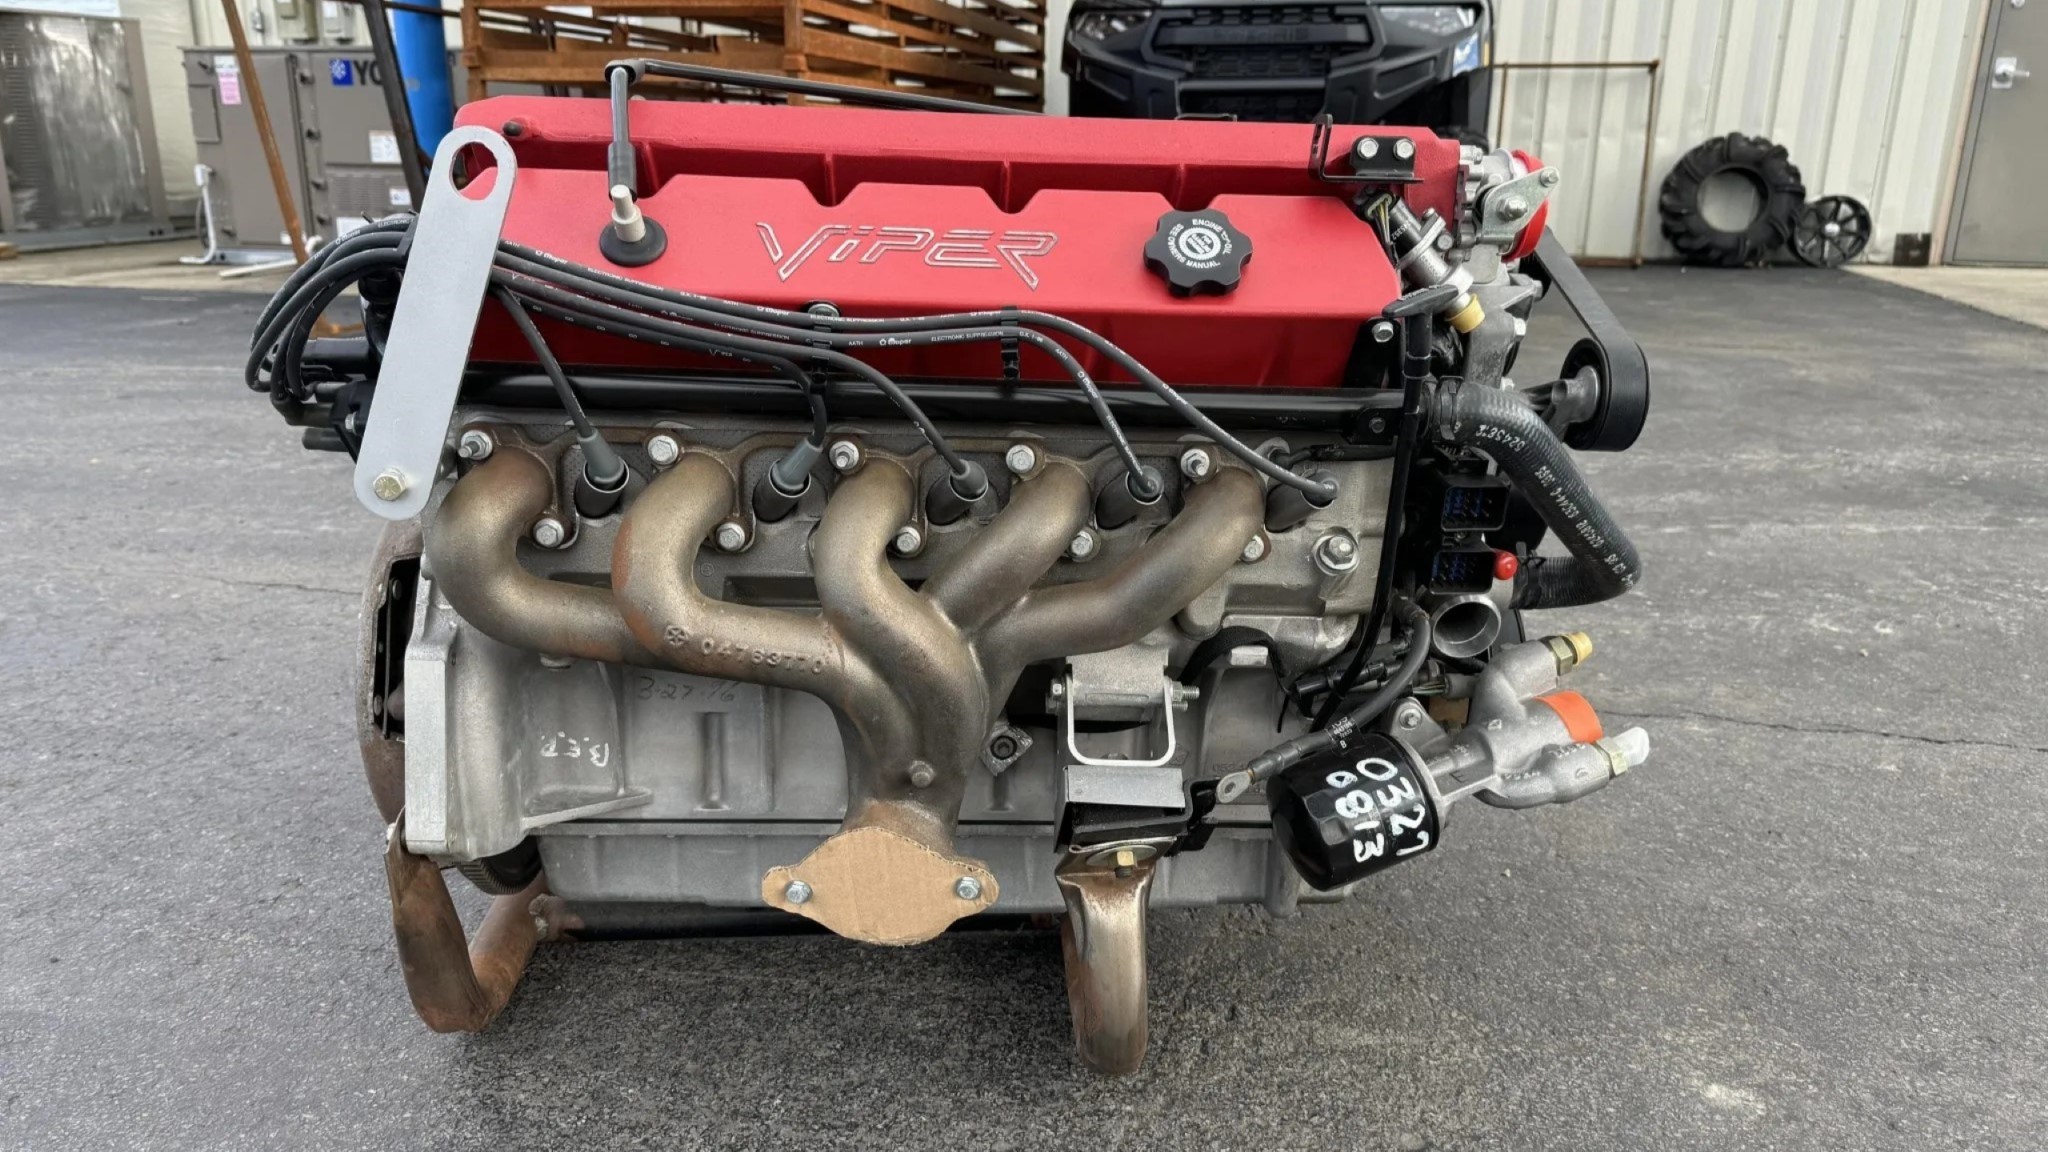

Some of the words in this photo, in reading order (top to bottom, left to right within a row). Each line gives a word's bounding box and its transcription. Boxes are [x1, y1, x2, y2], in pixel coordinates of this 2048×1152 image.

[353, 60, 383, 85] YO
[1169, 223, 1185, 236] SEE
[1192, 218, 1223, 232] ENGINE
[1222, 243, 1233, 255] OIL
[1167, 236, 1187, 263] OWNERS
[1186, 259, 1221, 269] MANUAL
[544, 252, 568, 264] Mopar
[587, 267, 623, 281] ELECTRONIC
[624, 277, 664, 291] SUPPRESSION
[765, 307, 790, 316] Mopar
[810, 314, 846, 322] ELECTRONIC
[887, 337, 912, 345] Mopar
[931, 333, 965, 342] ELECTRONIC
[966, 331, 1004, 339] SUPPRESSION
[1082, 377, 1099, 399] Mopar
[1356, 757, 1430, 857] 0327
